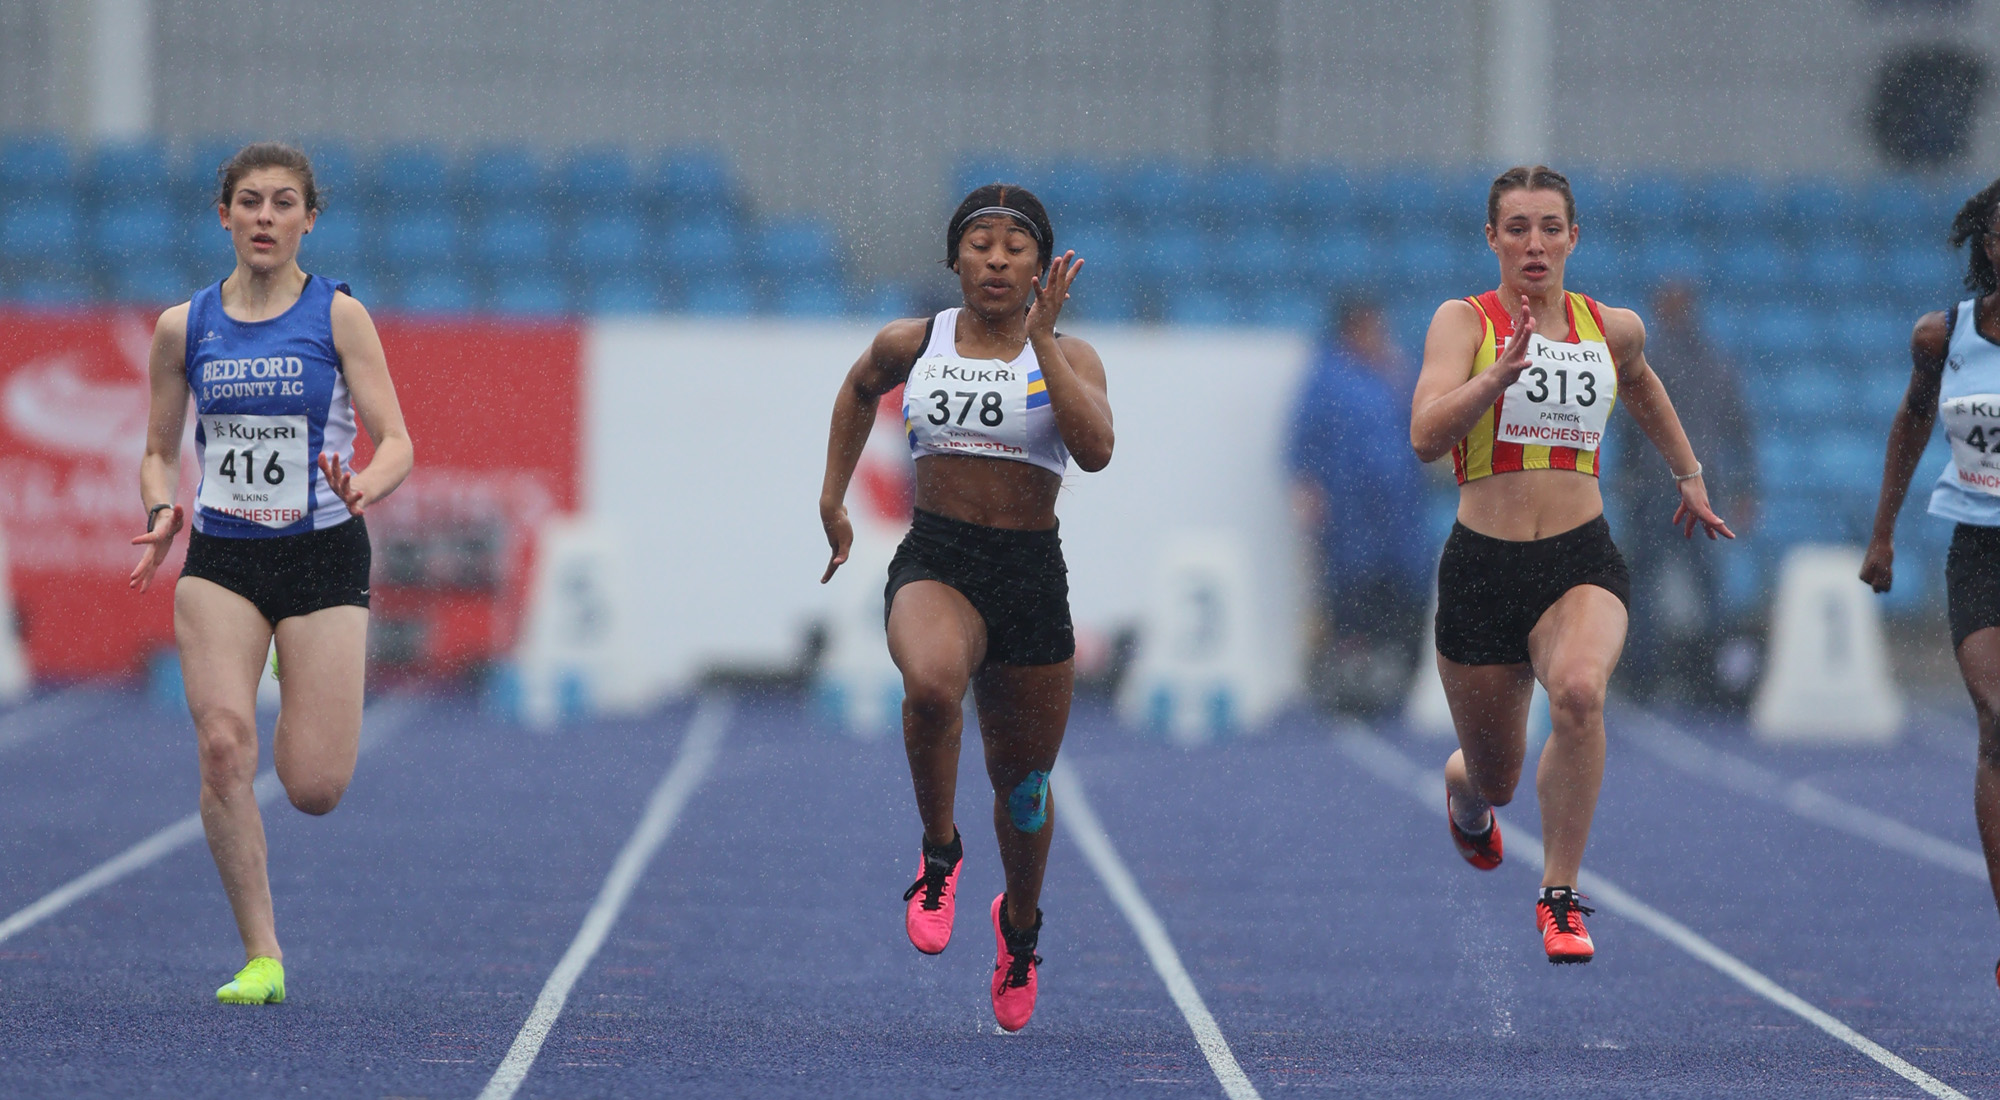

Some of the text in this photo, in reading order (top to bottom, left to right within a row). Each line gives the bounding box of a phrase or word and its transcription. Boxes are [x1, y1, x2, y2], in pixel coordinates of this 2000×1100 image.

[1537, 343, 1602, 363] KUKRI
[202, 357, 303, 382] BEDFORD
[941, 365, 1016, 382] KUKRI
[203, 381, 304, 400] & COUNTY AC
[1526, 367, 1597, 407] 313
[927, 389, 1004, 427] 378
[1540, 412, 1581, 423] PATRICK
[229, 423, 296, 440] KUKRI
[1505, 423, 1600, 444] MANCHESTER
[219, 448, 285, 485] 416
[232, 493, 269, 502] WILKINS
[210, 506, 302, 522] NCHESTER
